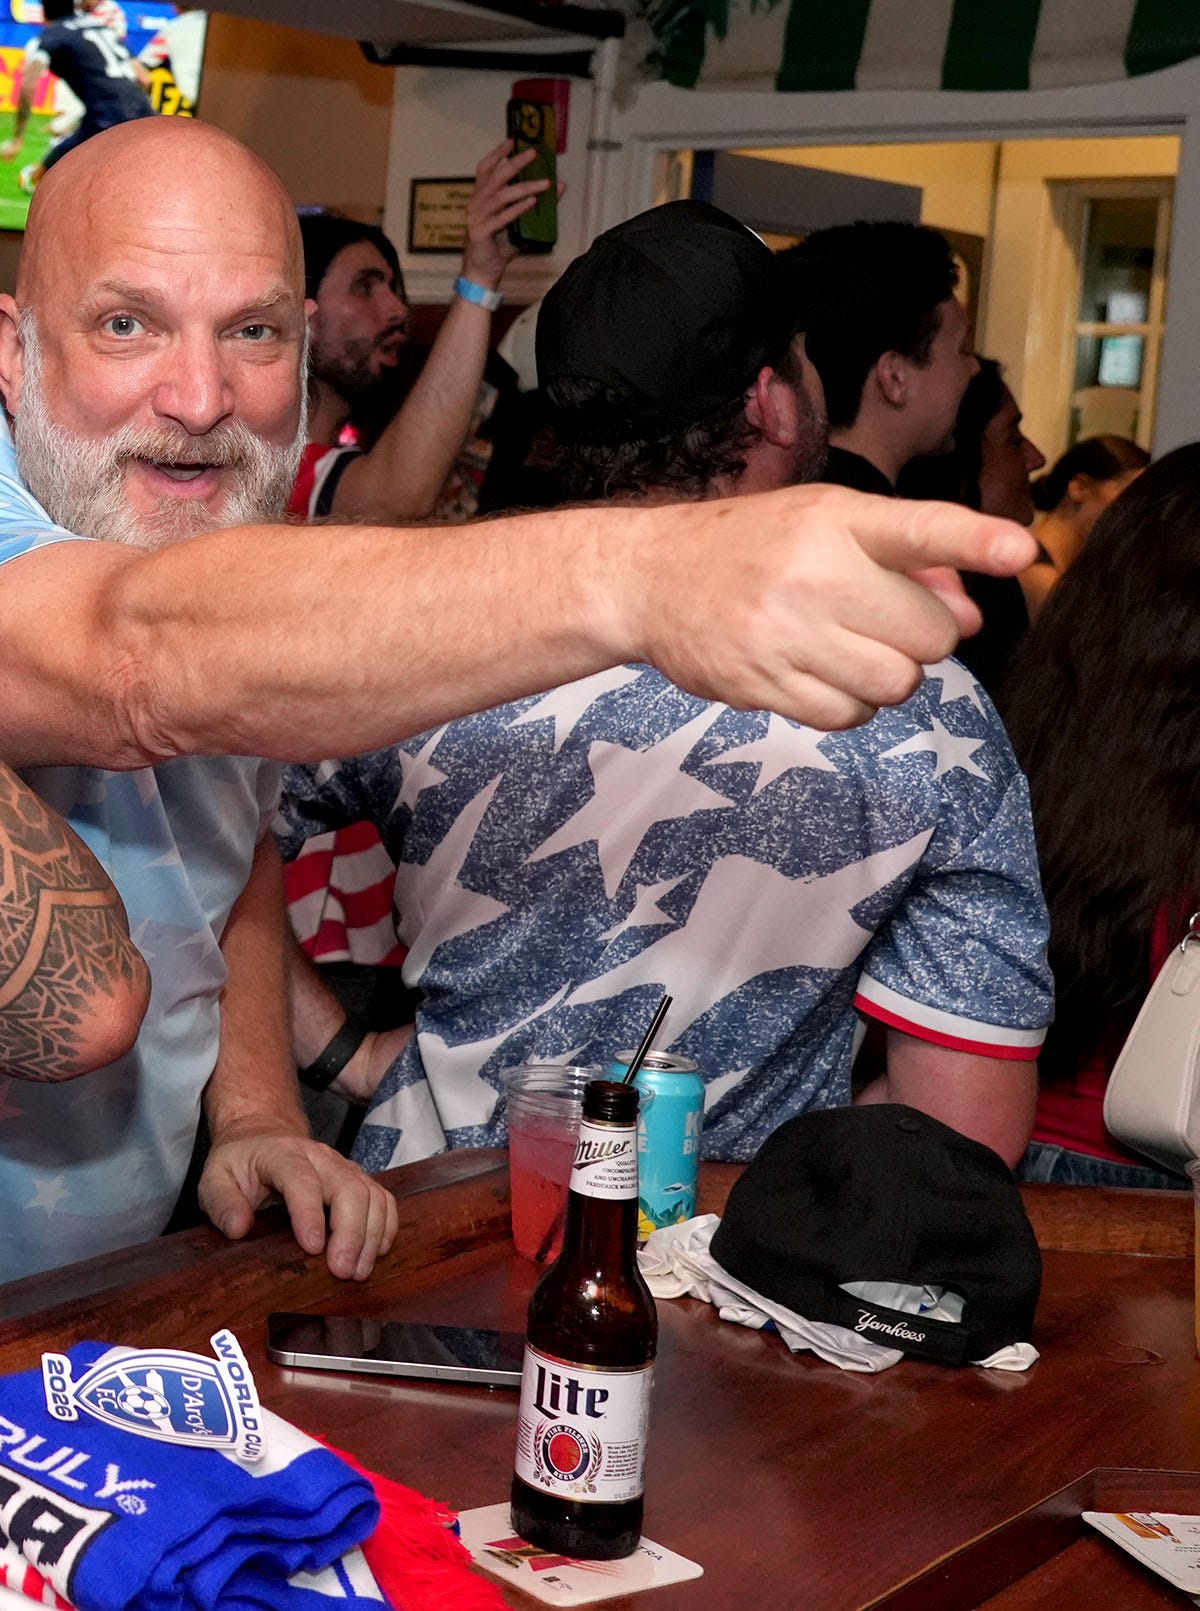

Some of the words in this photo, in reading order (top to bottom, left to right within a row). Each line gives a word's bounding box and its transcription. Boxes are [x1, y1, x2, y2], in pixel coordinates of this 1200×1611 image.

[577, 1139, 632, 1161] Miller
[854, 1309, 926, 1342] Yankees
[47, 1358, 73, 1419] 2026
[215, 1334, 258, 1431] WORLD
[242, 1433, 262, 1458] CUP
[533, 1364, 609, 1420] Lite
[547, 1425, 563, 1438] FINE
[564, 1426, 589, 1454] PILSNER
[553, 1470, 575, 1480] BEER
